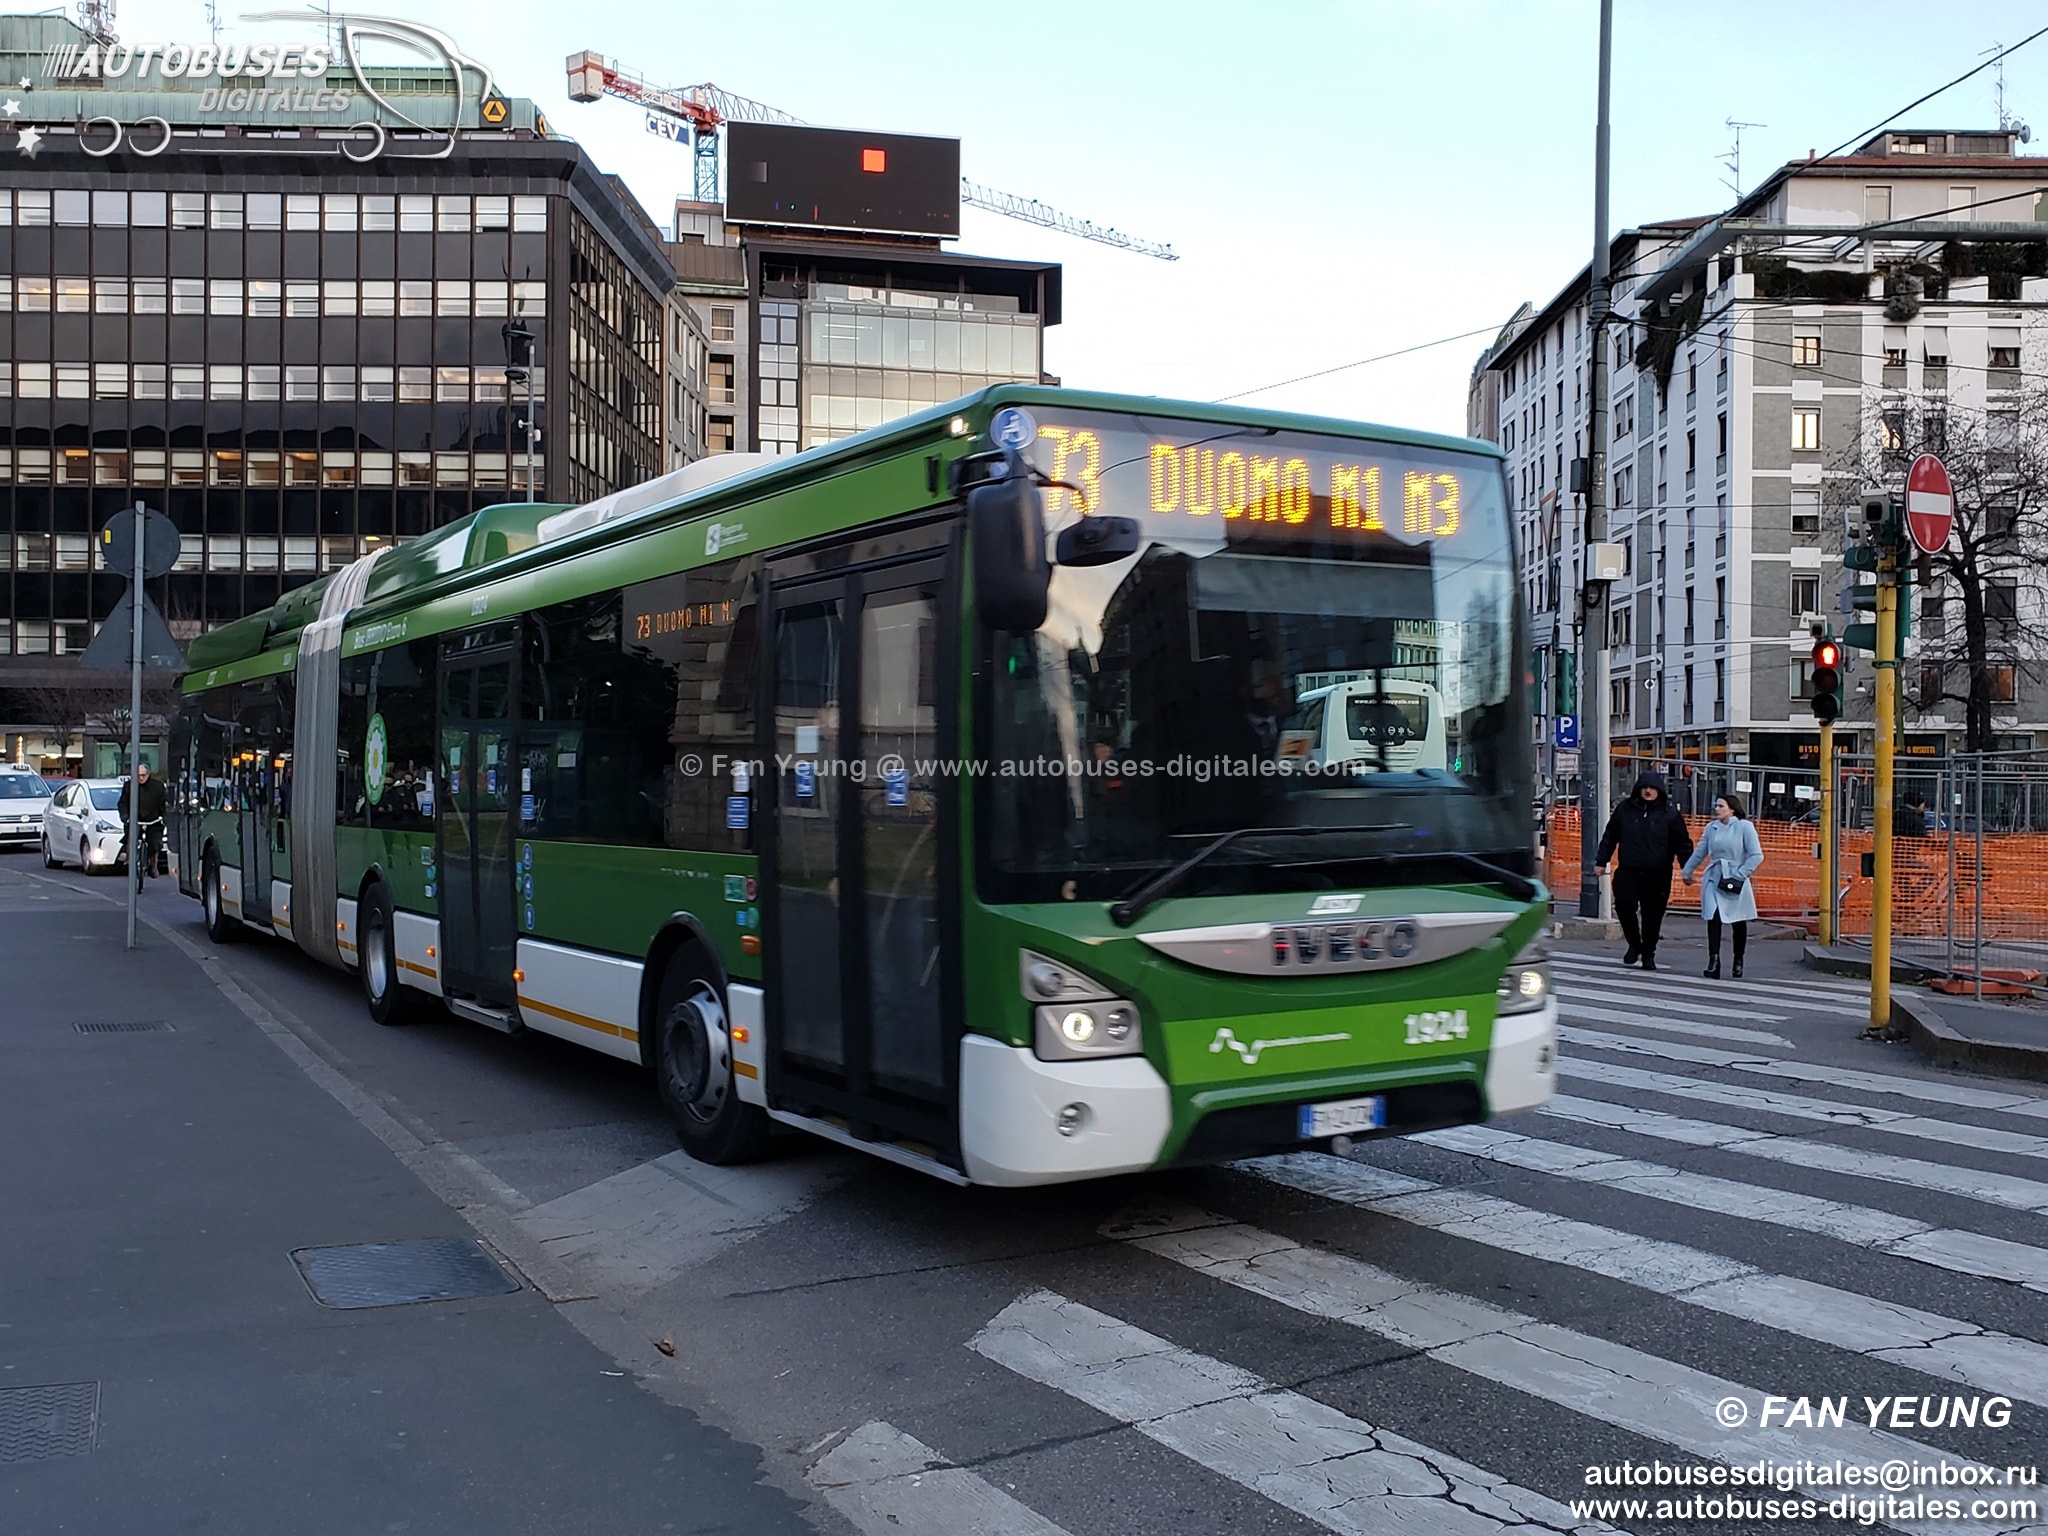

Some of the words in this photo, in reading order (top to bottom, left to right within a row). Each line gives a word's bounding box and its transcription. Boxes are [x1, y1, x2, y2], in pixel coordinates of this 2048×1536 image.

[647, 116, 680, 141] CEV
[1038, 427, 1101, 514] 73
[1149, 443, 1311, 524] DUOMO
[1331, 463, 1385, 531] M1
[1403, 470, 1461, 537] M3
[637, 614, 651, 639] 73
[1560, 716, 1573, 734] P
[1272, 920, 1418, 967] IVECO
[1403, 1009, 1469, 1045] 1924
